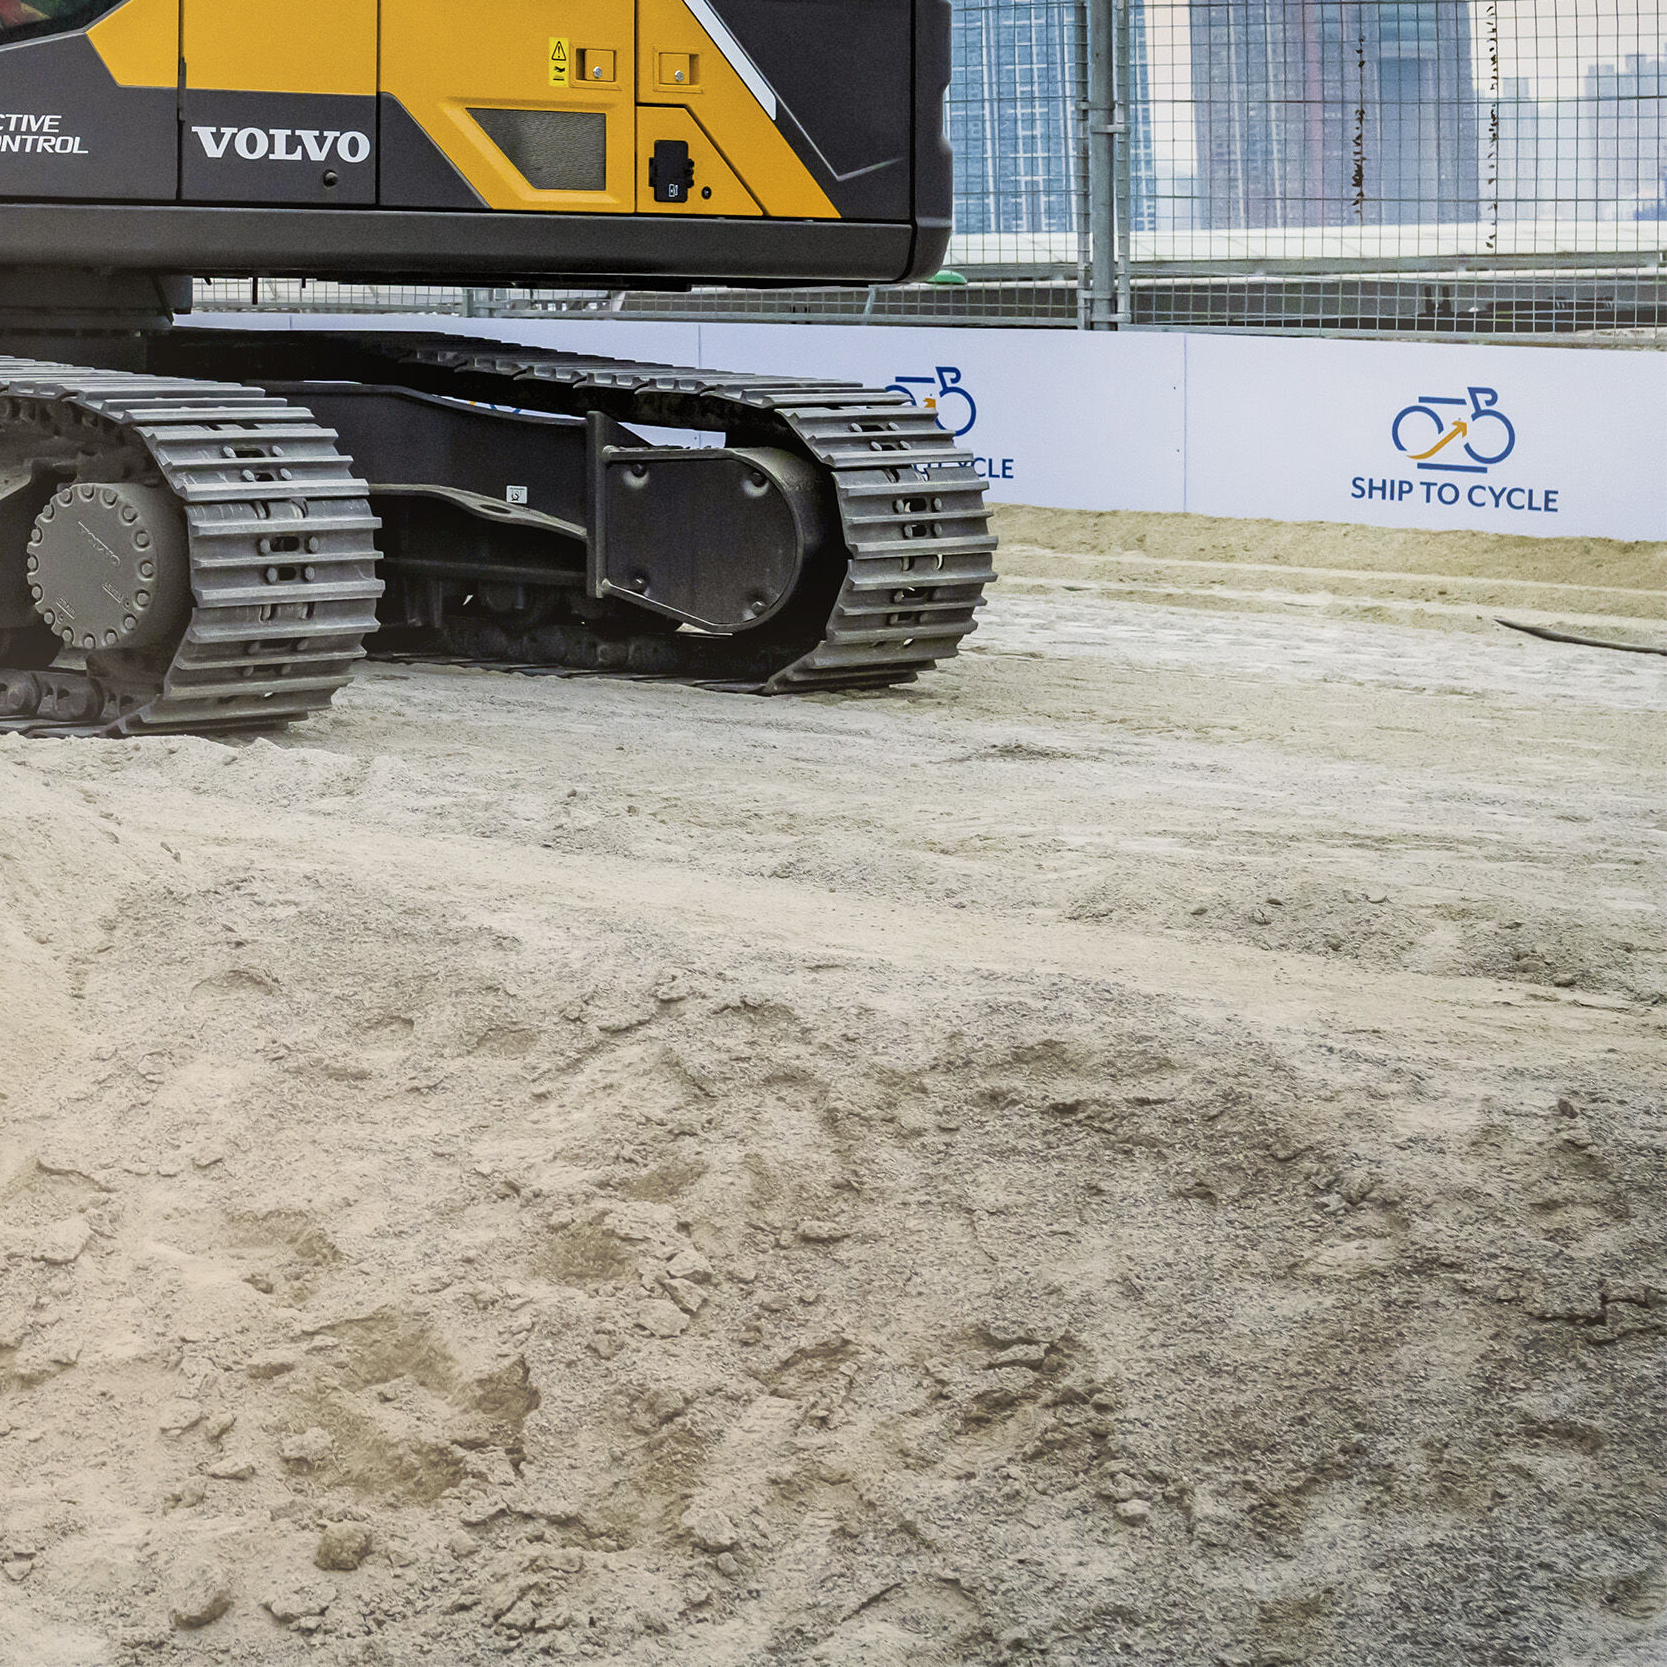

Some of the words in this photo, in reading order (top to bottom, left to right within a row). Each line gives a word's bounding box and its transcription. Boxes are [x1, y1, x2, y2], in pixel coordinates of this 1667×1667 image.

[192, 126, 370, 163] VOLVO
[1350, 476, 1414, 502] SHIP
[1419, 481, 1460, 506] TO
[1467, 484, 1559, 513] CYCLE
